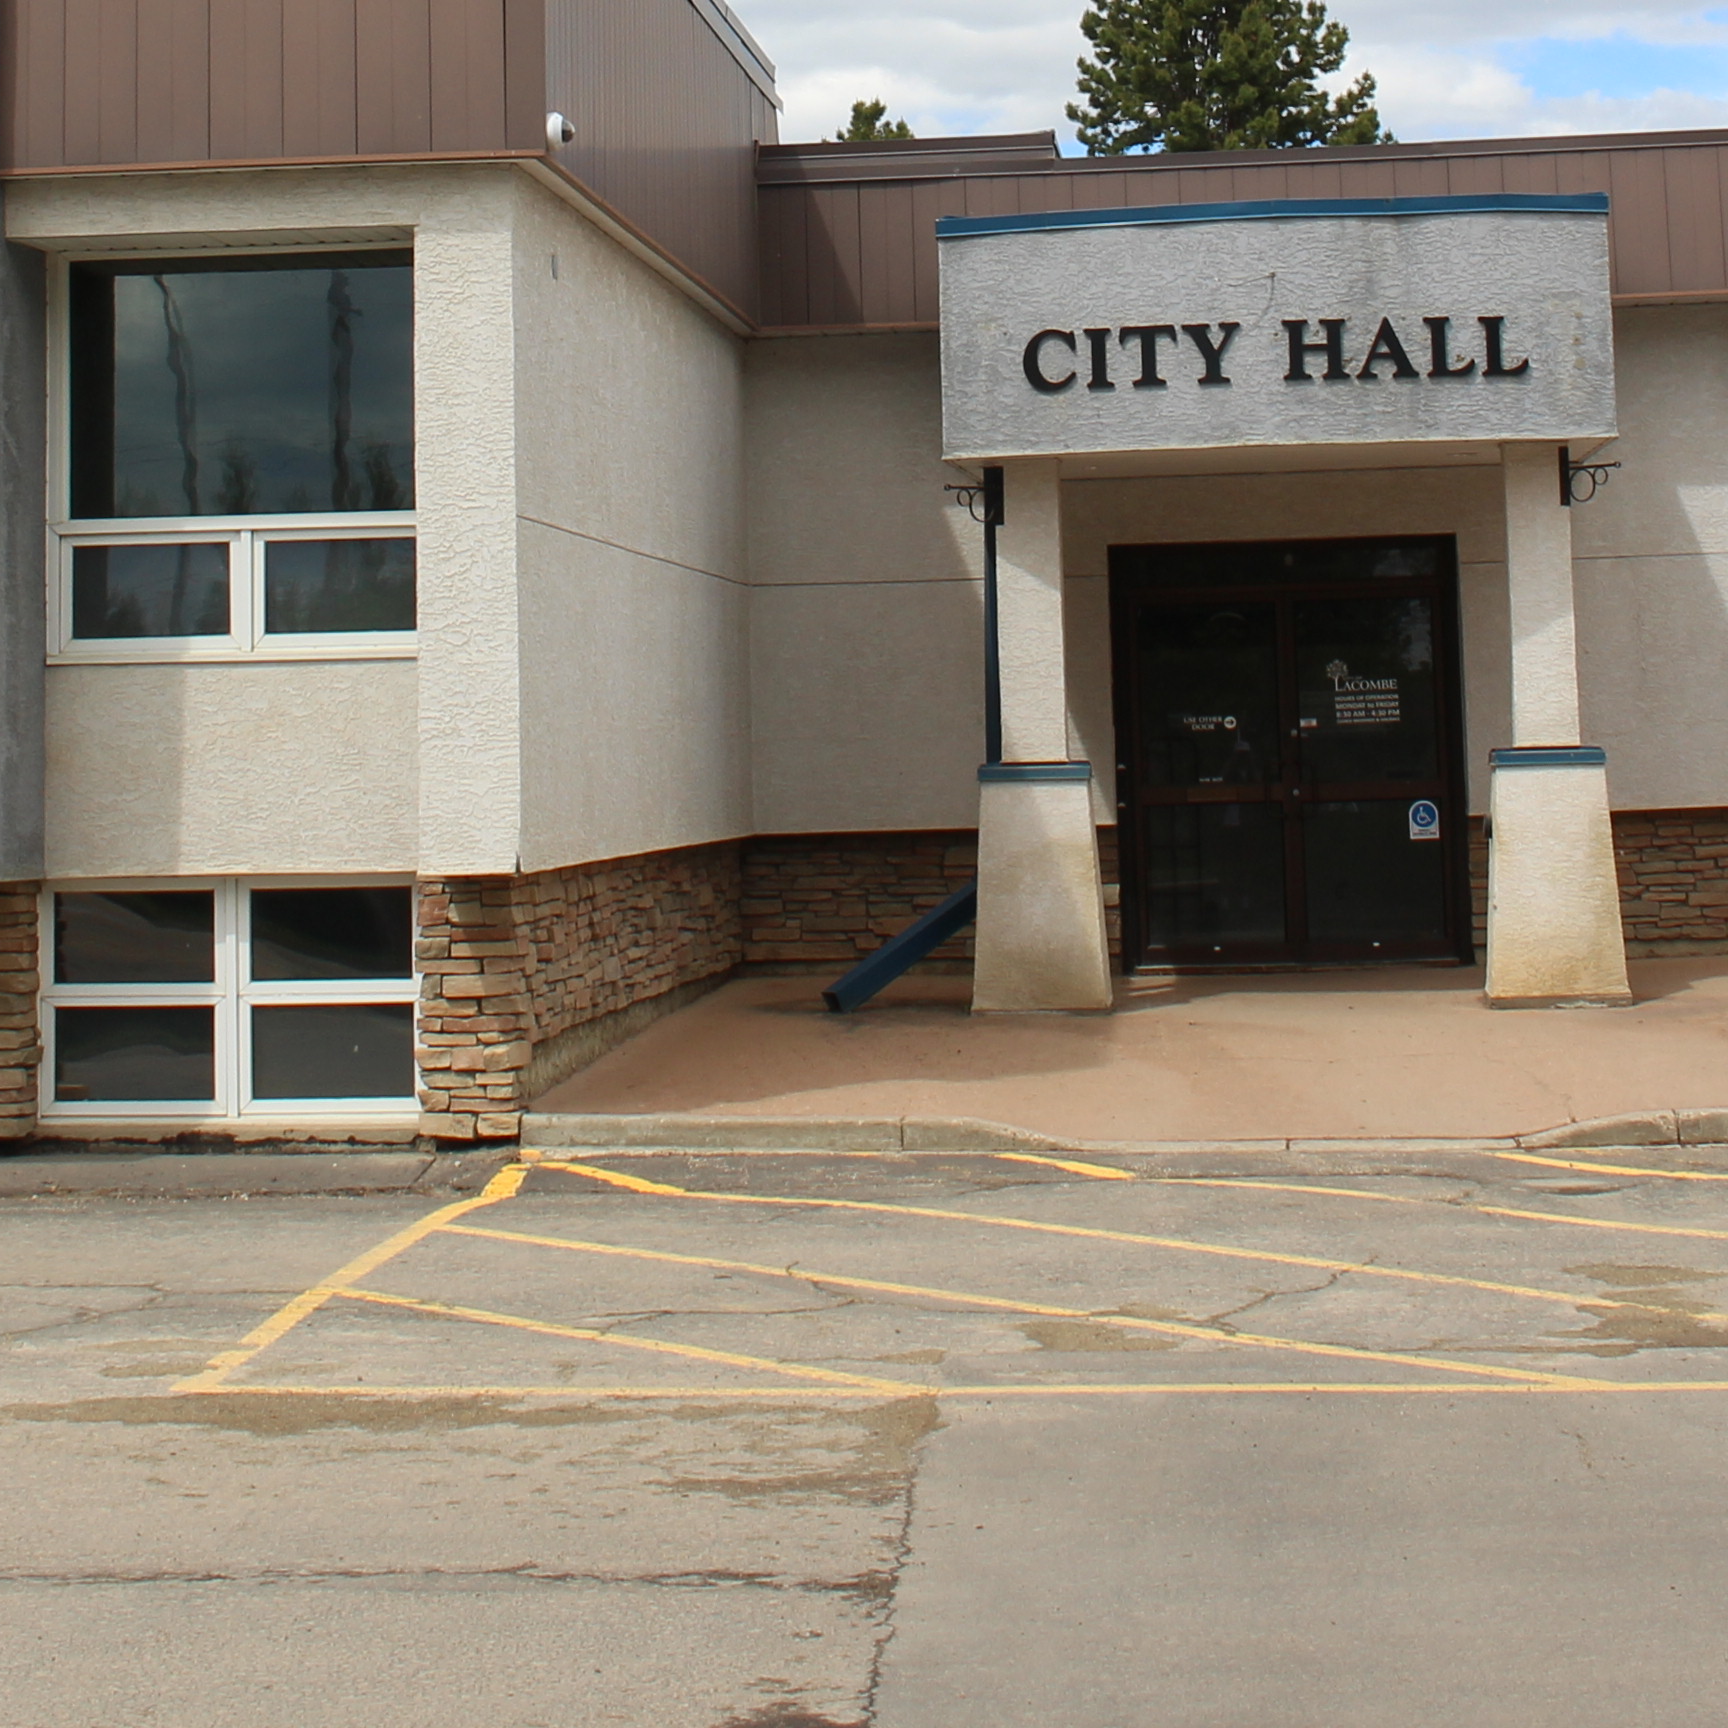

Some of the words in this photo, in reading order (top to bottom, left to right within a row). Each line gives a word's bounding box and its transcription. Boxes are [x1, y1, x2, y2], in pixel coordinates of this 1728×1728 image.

[1022, 322, 1242, 395] CITY
[1281, 315, 1531, 382] HALL
[1334, 676, 1398, 692] LACOMBE
